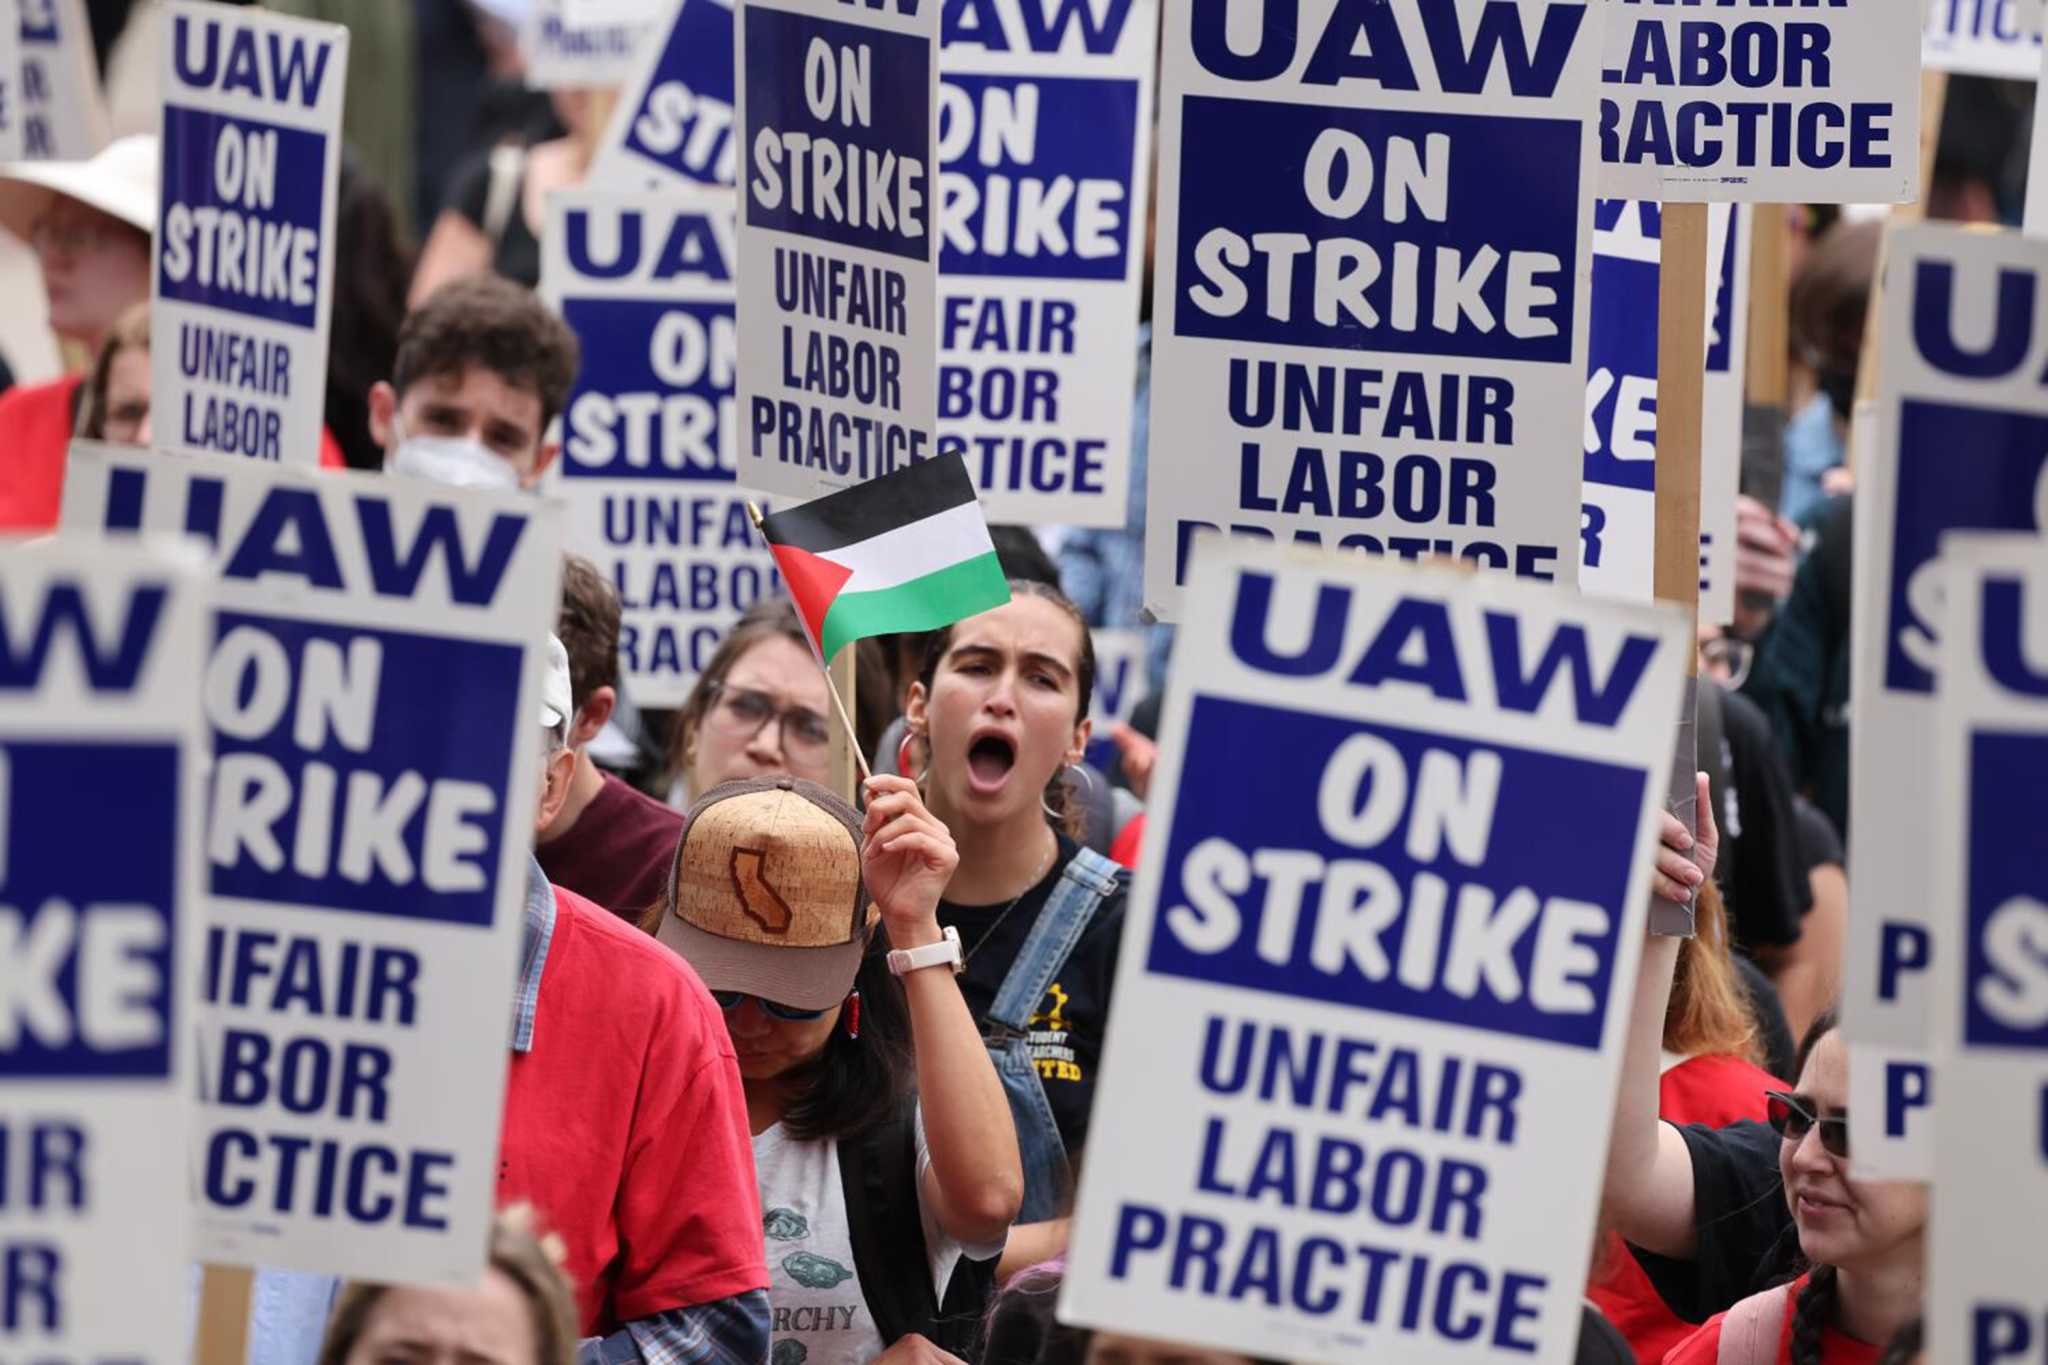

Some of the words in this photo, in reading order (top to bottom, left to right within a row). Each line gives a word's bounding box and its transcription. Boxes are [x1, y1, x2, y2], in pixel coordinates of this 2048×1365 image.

[173, 16, 332, 108] UAW
[805, 36, 871, 128] ON
[1191, 0, 1588, 98] UAW
[214, 123, 278, 210] ON
[752, 126, 924, 239] STRIKE
[1303, 127, 1451, 224] ON
[163, 204, 317, 306] STRIKE
[776, 248, 907, 336] UNFAIR
[1188, 227, 1563, 339] STRIKE
[180, 323, 291, 398] UNFAIR
[782, 326, 900, 411] LABOR
[1227, 358, 1515, 446] UNFAIR
[183, 394, 281, 462] LABOR
[751, 396, 928, 480] PRACTICE
[1238, 442, 1497, 528] LABOR
[206, 625, 384, 753] ON
[1229, 568, 1663, 729] UAW
[1318, 732, 1503, 868] ON
[1166, 836, 1611, 1015] STRIKE
[198, 1025, 393, 1125] BOR
[1199, 1015, 1526, 1146] UNFAIR
[1194, 1115, 1489, 1241] LABOR
[1106, 1200, 1549, 1356] PRACTICE
